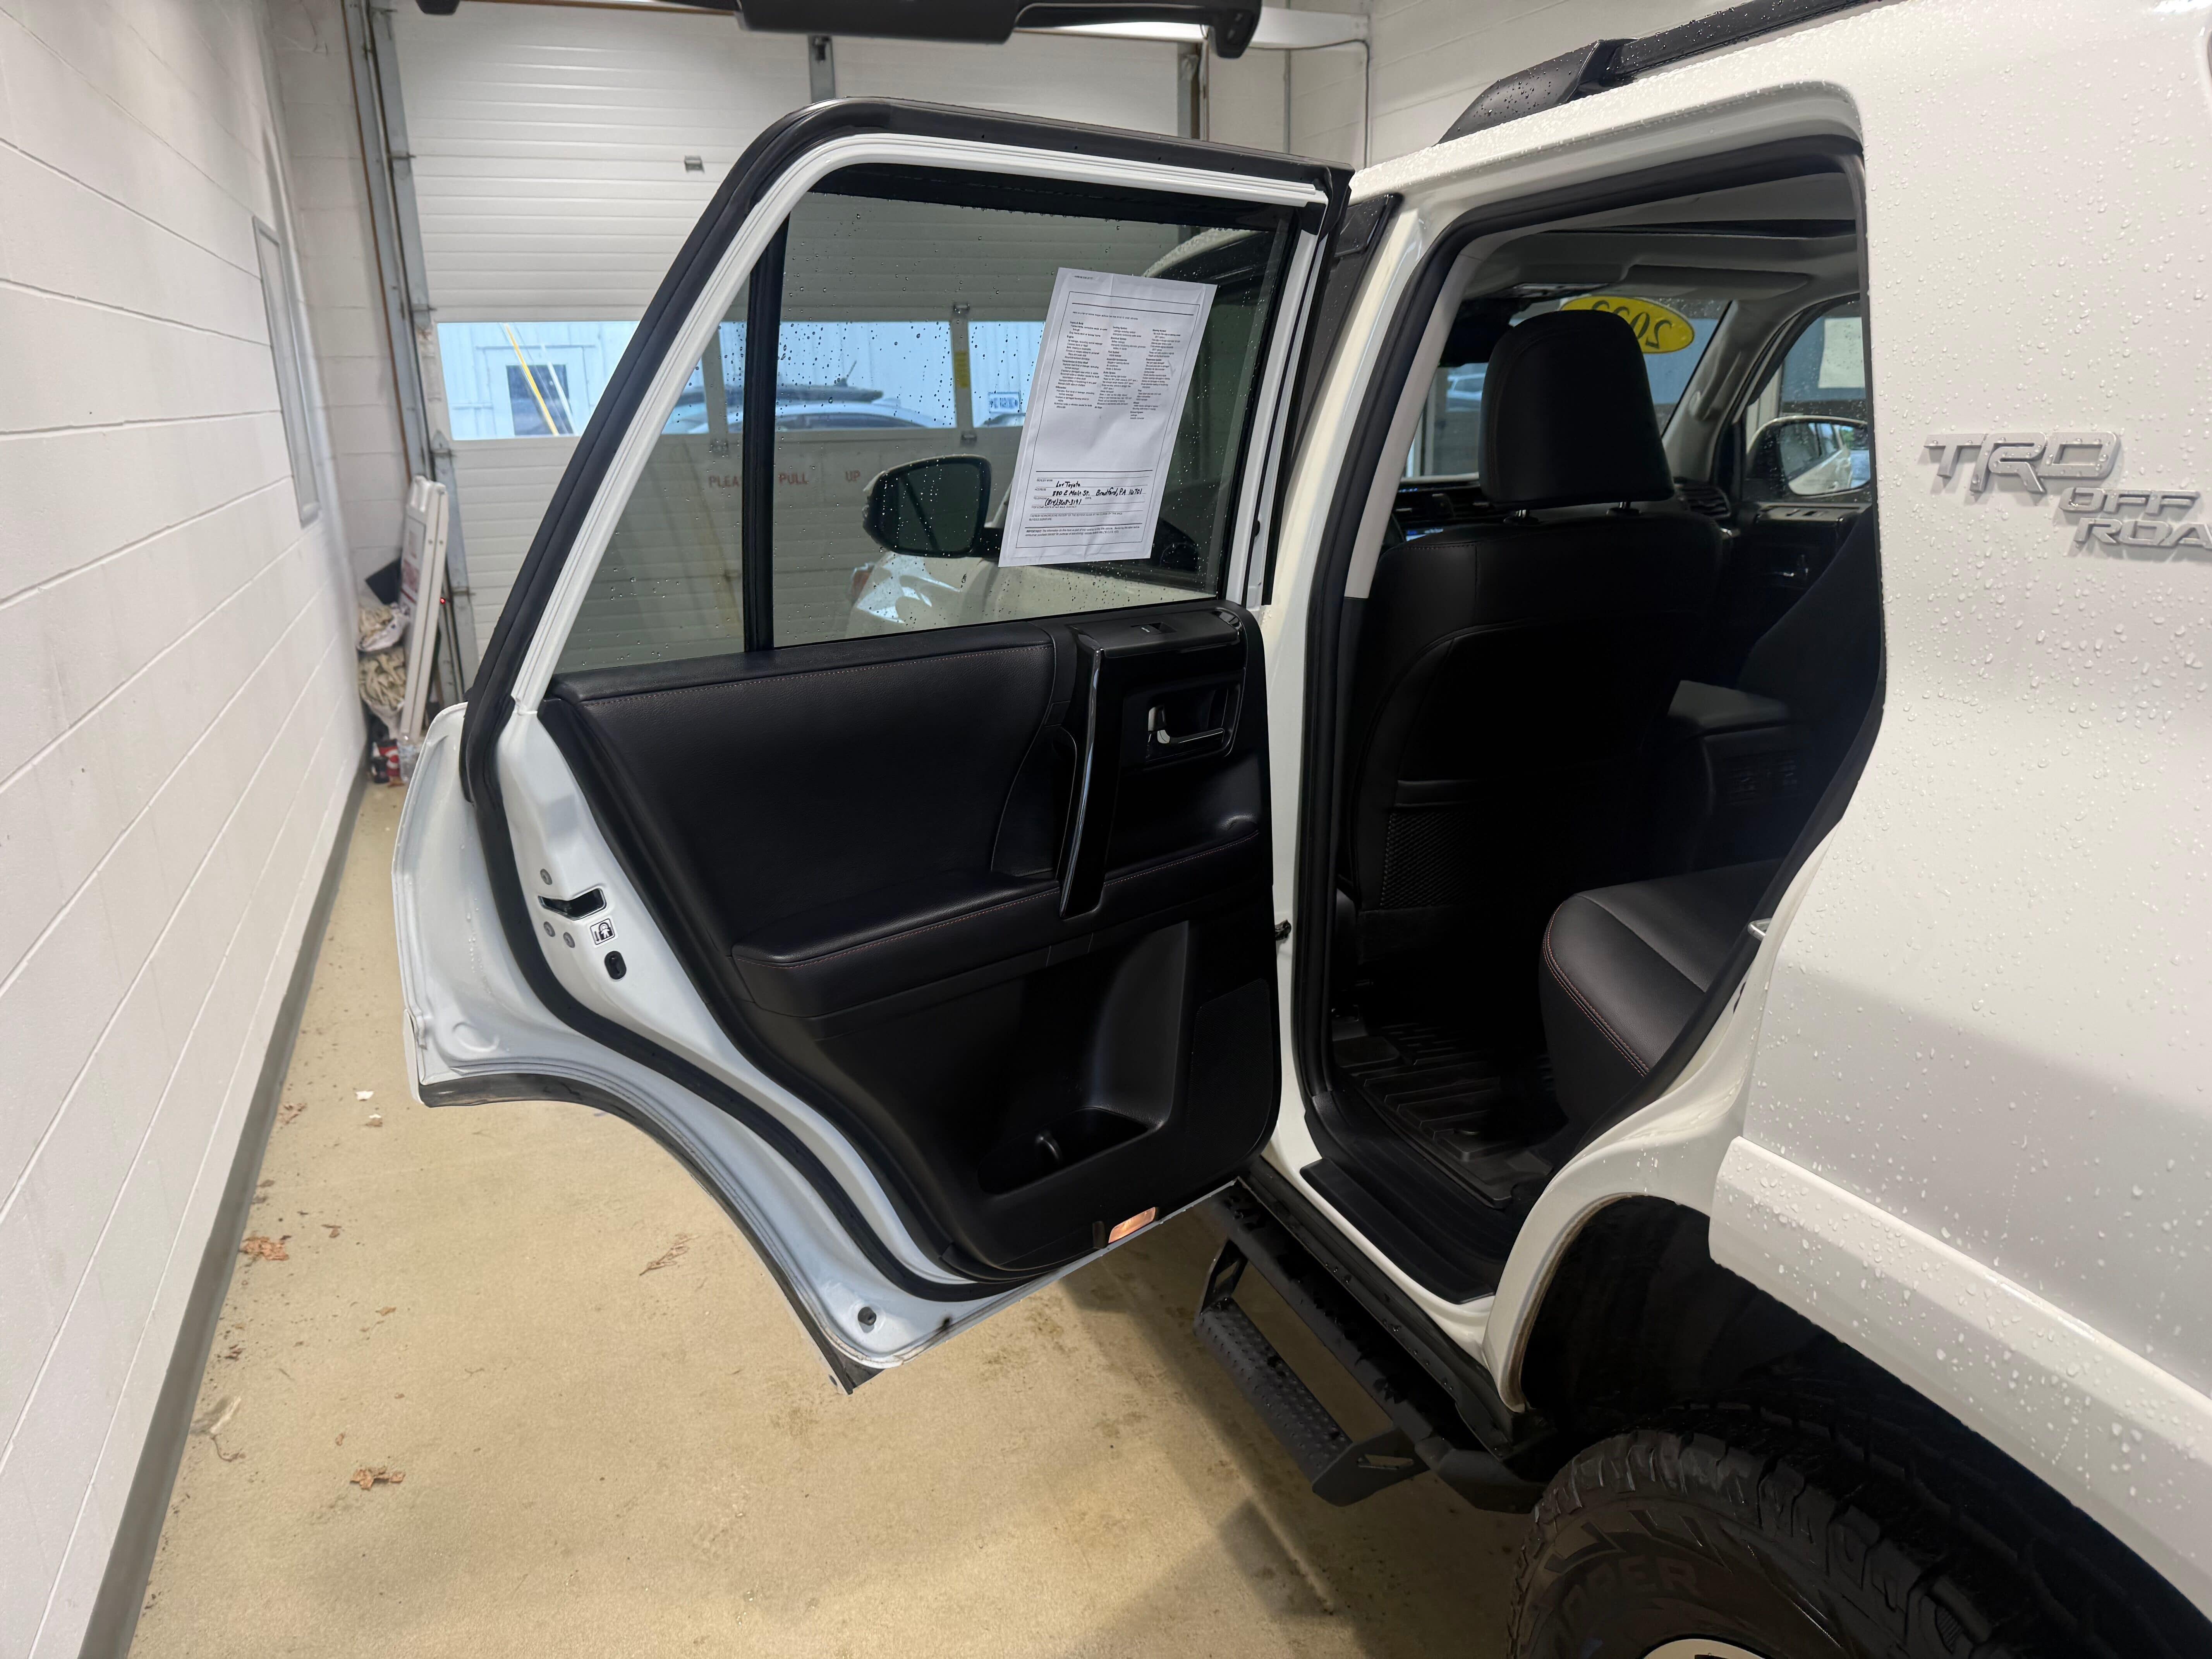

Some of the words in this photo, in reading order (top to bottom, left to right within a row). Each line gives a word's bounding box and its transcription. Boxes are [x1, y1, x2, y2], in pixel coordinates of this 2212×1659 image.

[1923, 431, 2121, 493] TRD
[708, 475, 742, 488] PLEA
[778, 471, 809, 485] PULL
[845, 470, 861, 482] UP
[1065, 481, 1080, 489] Toyota
[2059, 487, 2200, 515] OFF
[2073, 517, 2212, 549] ROA
